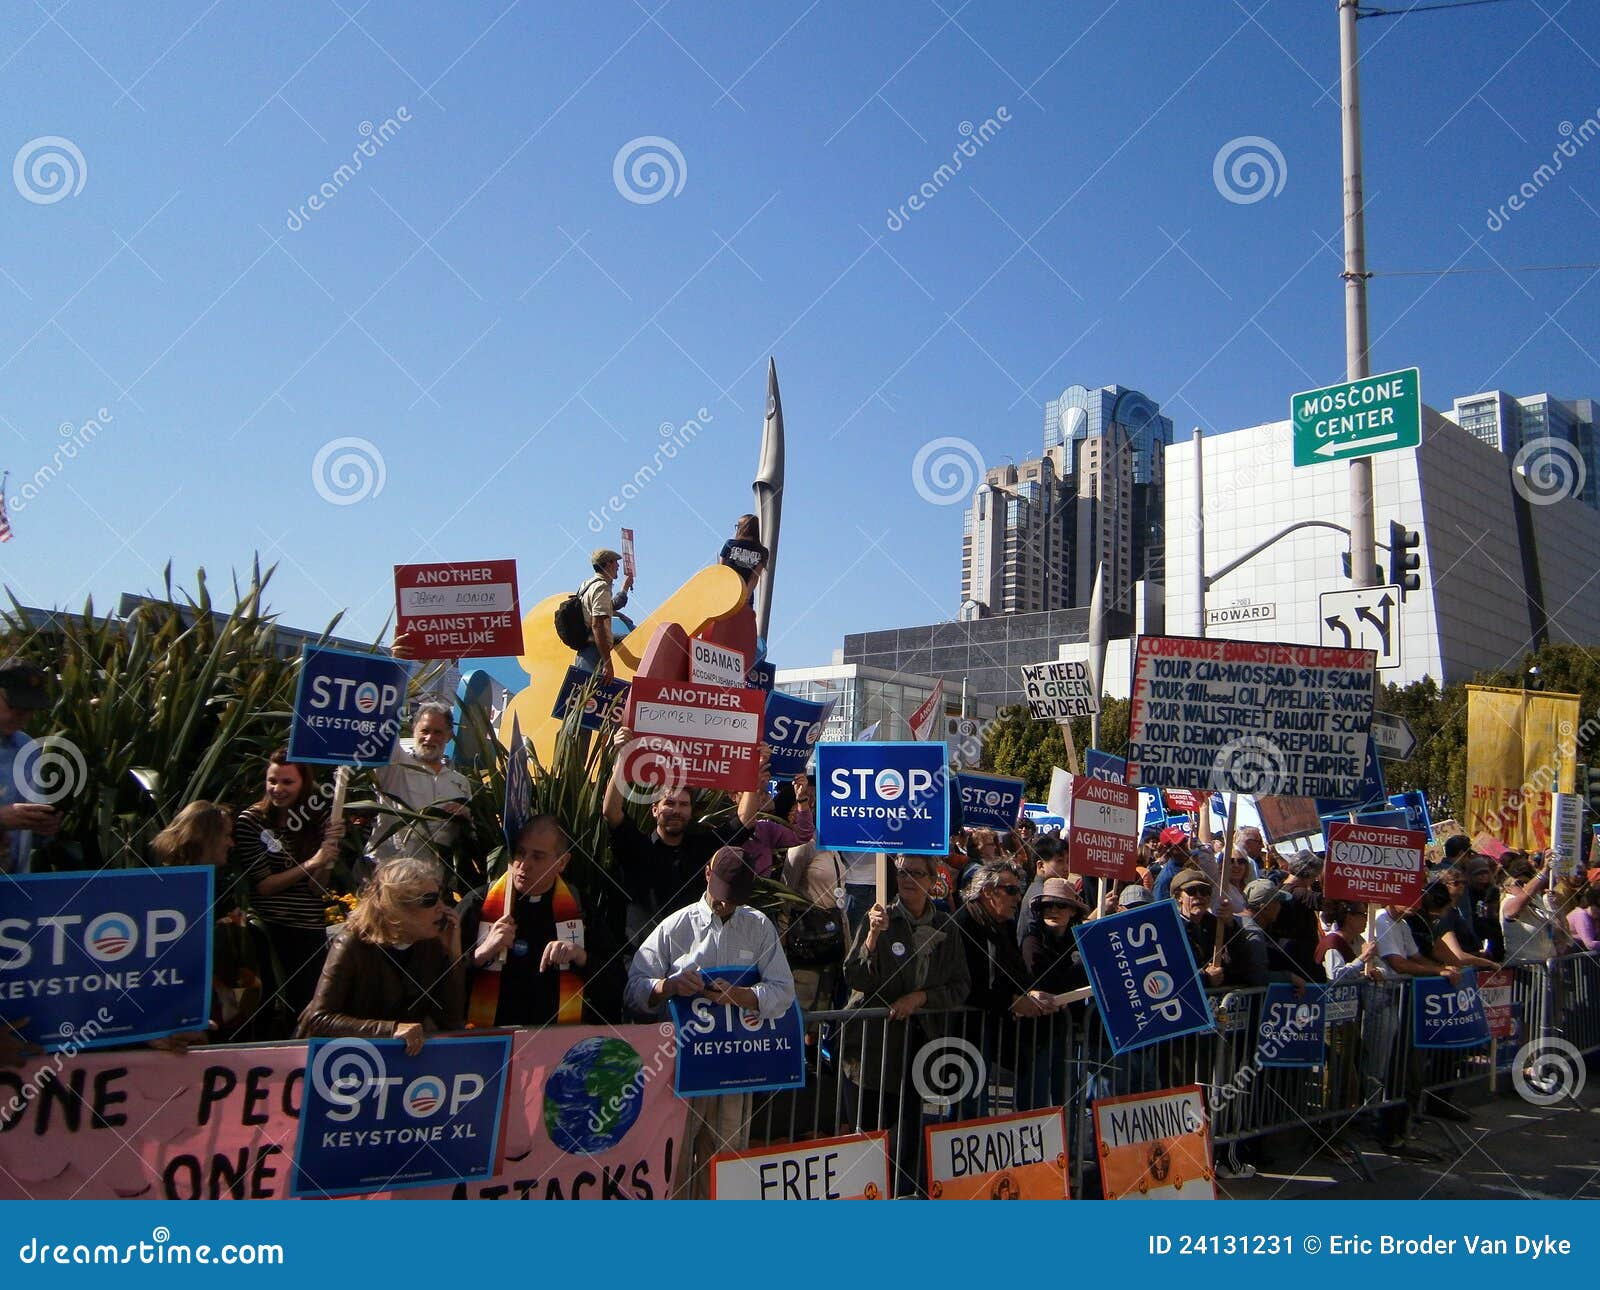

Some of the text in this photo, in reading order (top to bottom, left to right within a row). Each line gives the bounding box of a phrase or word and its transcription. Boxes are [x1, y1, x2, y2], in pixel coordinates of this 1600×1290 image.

[1304, 379, 1404, 416] MOSCONE
[1315, 407, 1394, 438] CENTER
[416, 568, 493, 583] ANOTHER
[455, 591, 497, 603] DONOR
[405, 615, 512, 632] AGAINST THE
[1211, 606, 1270, 622] HOWARD
[425, 631, 496, 646] PIPELINE
[1139, 636, 1221, 660] CORPORATE
[695, 646, 741, 673] OBAMA'S
[1021, 662, 1086, 681] WE NEED
[1136, 657, 1148, 675] F
[1154, 659, 1192, 679] YOUR
[1327, 670, 1372, 691] SCAM
[310, 675, 398, 715] STOP
[658, 687, 741, 708] ANOTHER
[1027, 680, 1093, 698] A GREEN
[1136, 678, 1148, 697] F
[1149, 680, 1185, 701] YOUR
[1333, 691, 1374, 713] WARS
[639, 706, 750, 730] FORMER DONOR
[1028, 699, 1057, 719] NEW
[1132, 698, 1145, 719] F
[1147, 701, 1181, 722] YOUR
[1183, 703, 1272, 728] WALLSTREET
[1273, 710, 1330, 732] BAILOUT
[1331, 713, 1371, 734] SCAM
[1130, 720, 1144, 740] F
[1144, 723, 1180, 743] YOUR
[637, 738, 752, 760] AGAINST THE
[655, 755, 731, 775] PIPELINE
[1125, 762, 1139, 784] F
[1140, 764, 1176, 787] YOUR
[1176, 767, 1211, 790] NEW
[1303, 755, 1361, 777] EMPIRE
[831, 768, 932, 801] STOP
[1086, 785, 1129, 805] ANOTHER
[961, 787, 1014, 807] STOP
[831, 806, 932, 819] KEYSTONE XL
[963, 804, 999, 816] EYSTONE
[1075, 831, 1134, 853] AGAINST THE
[1348, 830, 1409, 845] ANOTHER
[1086, 848, 1125, 865] PIPELINE
[1335, 840, 1417, 869] GODDESS
[1334, 866, 1416, 884] AGAINST THE
[1348, 880, 1402, 894] PIPELINE
[0, 909, 186, 970] STOP
[152, 968, 184, 986] XL
[1108, 931, 1149, 1031] KEYSTONE XL
[1127, 922, 1182, 1022] STOP
[1425, 987, 1476, 1015] STOP
[1270, 1002, 1321, 1029] STOP
[1425, 1016, 1473, 1027] KEYSTONE
[694, 1037, 791, 1056] KEYSTONE XL
[1311, 1033, 1319, 1041] XL
[326, 1074, 484, 1122] STOP
[1111, 1099, 1195, 1147] MANNING
[322, 1123, 477, 1148] KEYSTONE XL
[950, 1124, 1044, 1177] BRADLEY
[162, 1143, 283, 1200] ONE
[760, 1153, 840, 1200] FREE
